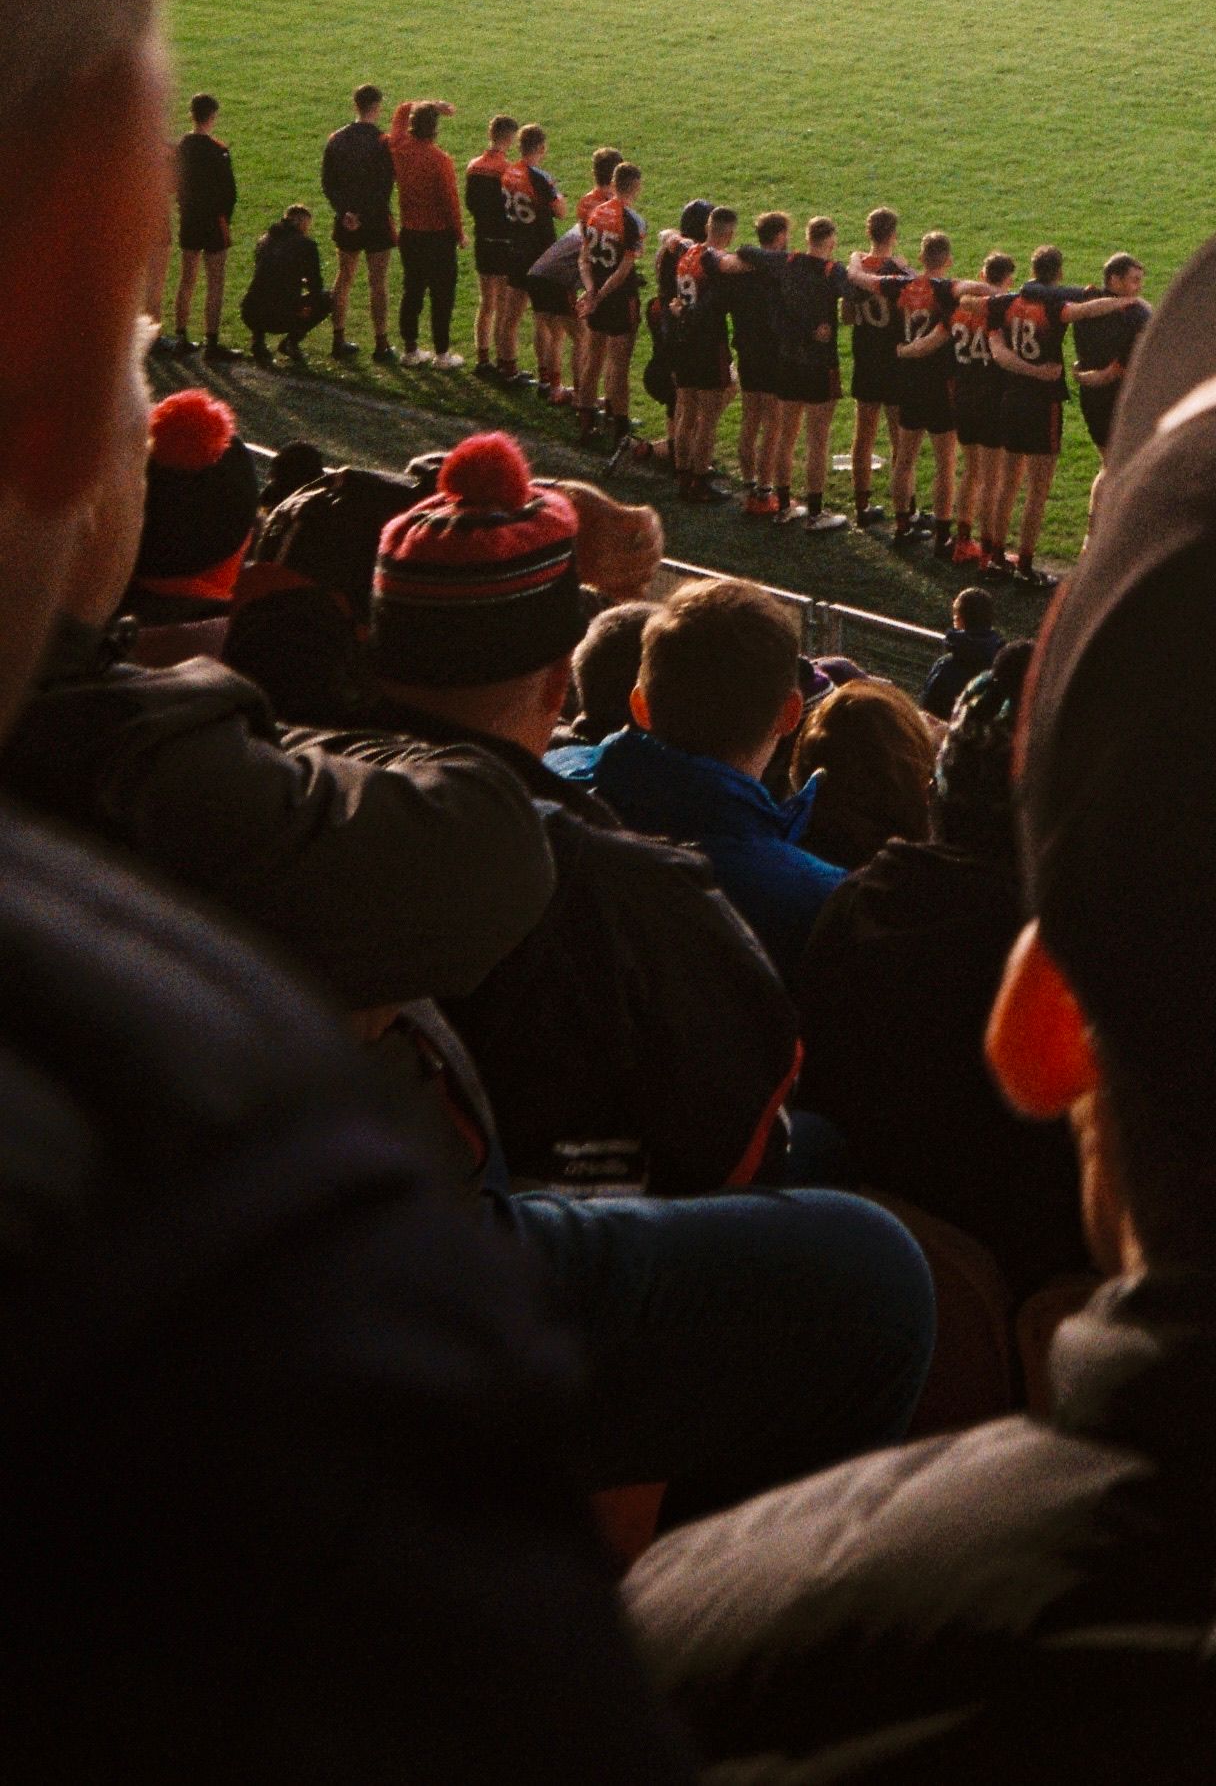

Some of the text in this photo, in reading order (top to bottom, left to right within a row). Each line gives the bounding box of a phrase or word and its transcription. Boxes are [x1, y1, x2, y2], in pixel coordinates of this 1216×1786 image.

[586, 226, 620, 268] 25
[951, 323, 991, 367] 24
[1011, 316, 1041, 360] 18
